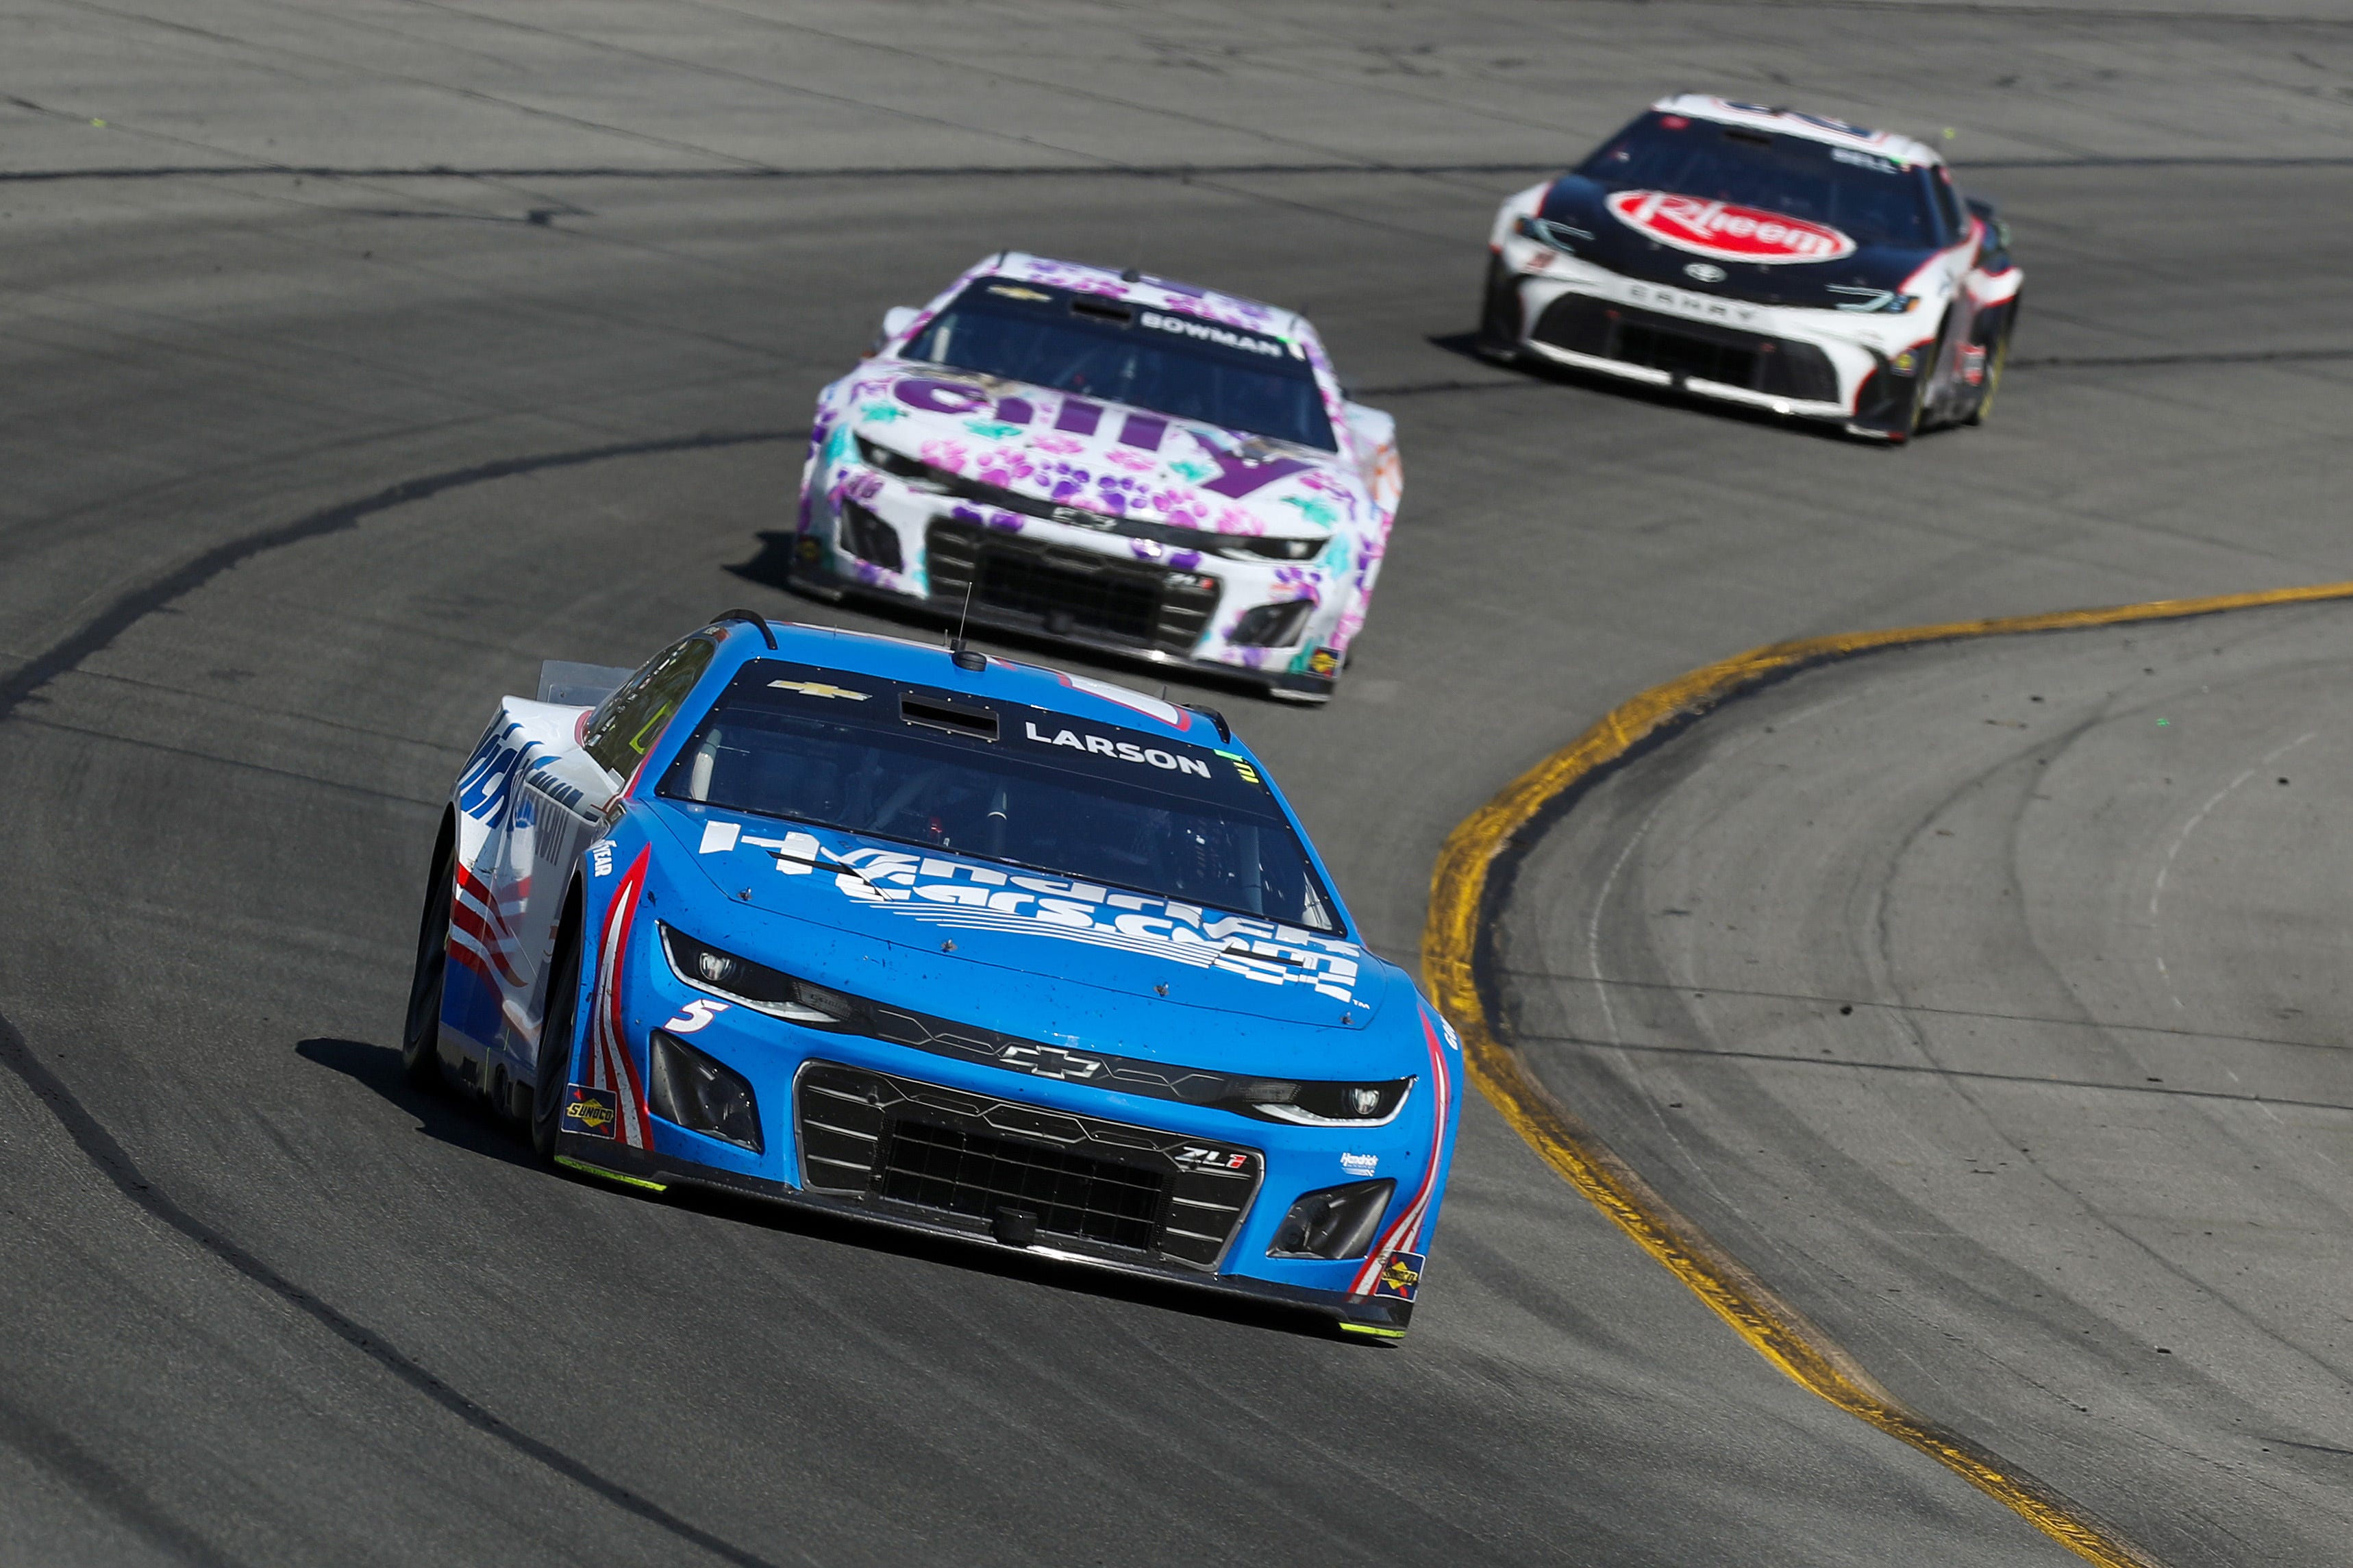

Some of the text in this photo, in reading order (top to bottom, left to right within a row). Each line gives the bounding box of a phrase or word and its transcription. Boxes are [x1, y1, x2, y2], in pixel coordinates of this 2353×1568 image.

[1634, 192, 1832, 257] Rheem
[1141, 311, 1283, 358] BOWMAN
[1025, 721, 1212, 779] LARSON
[663, 998, 732, 1035] 5
[569, 1104, 613, 1121] SUNOCO
[1174, 1146, 1247, 1169] ZL1
